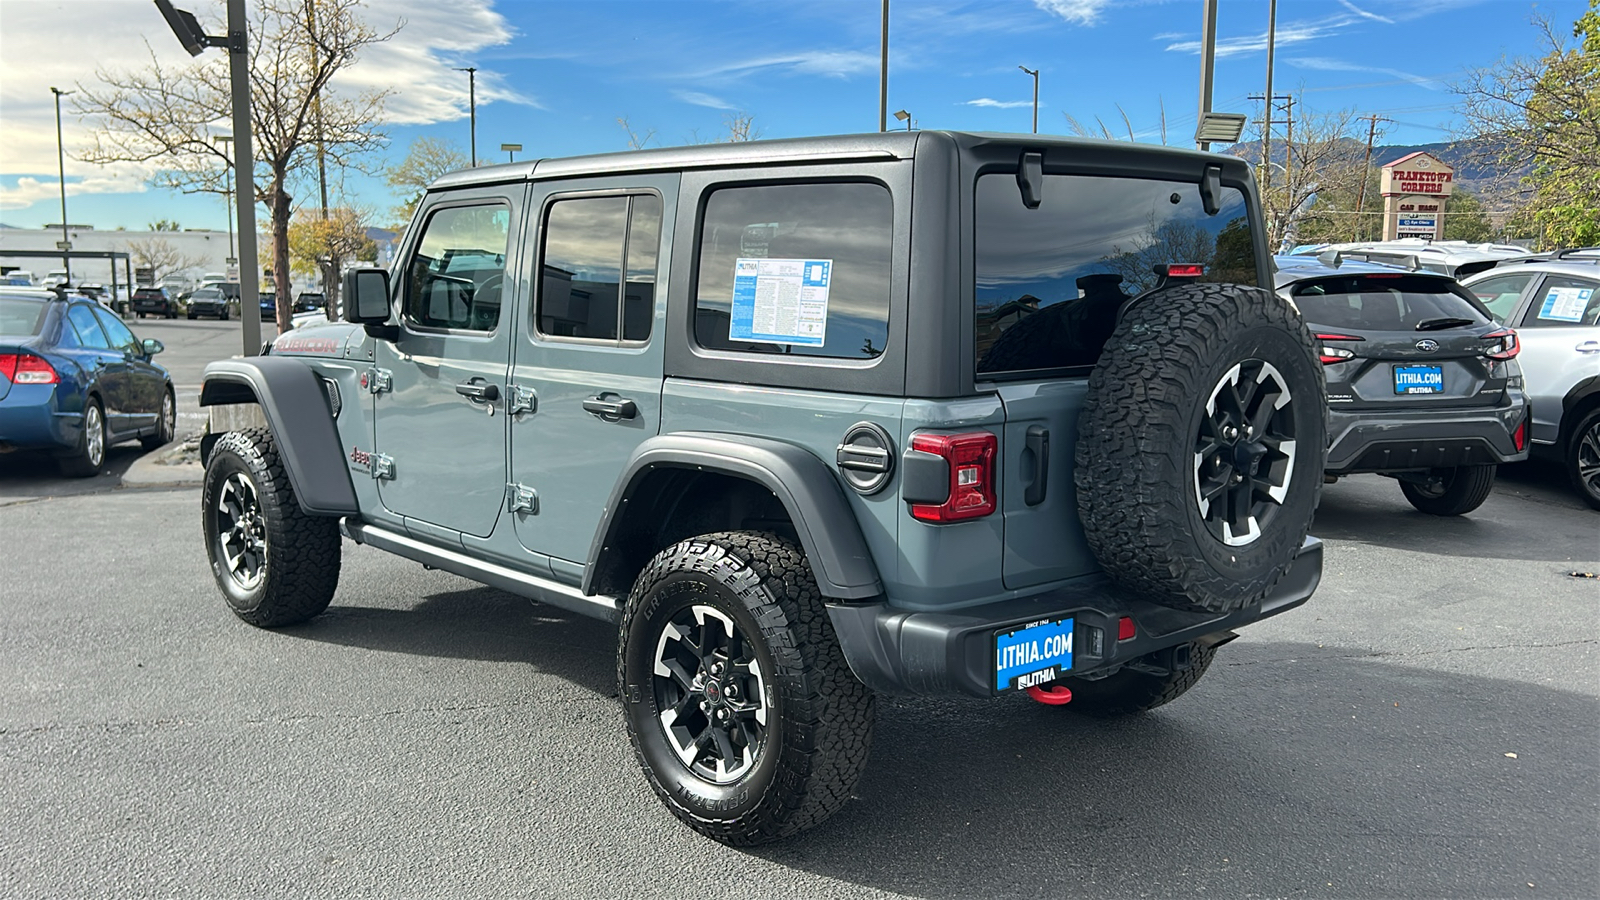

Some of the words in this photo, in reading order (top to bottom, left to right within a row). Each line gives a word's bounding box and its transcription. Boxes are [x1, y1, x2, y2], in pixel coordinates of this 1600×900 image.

[1392, 171, 1452, 183] FRANKTOWN
[1401, 182, 1442, 193] CORNERS
[273, 338, 338, 353] RUBICON
[1396, 373, 1442, 384] LITHIA.COM
[997, 632, 1073, 671] LITHIA.COM
[1026, 667, 1056, 687] LITHIA
